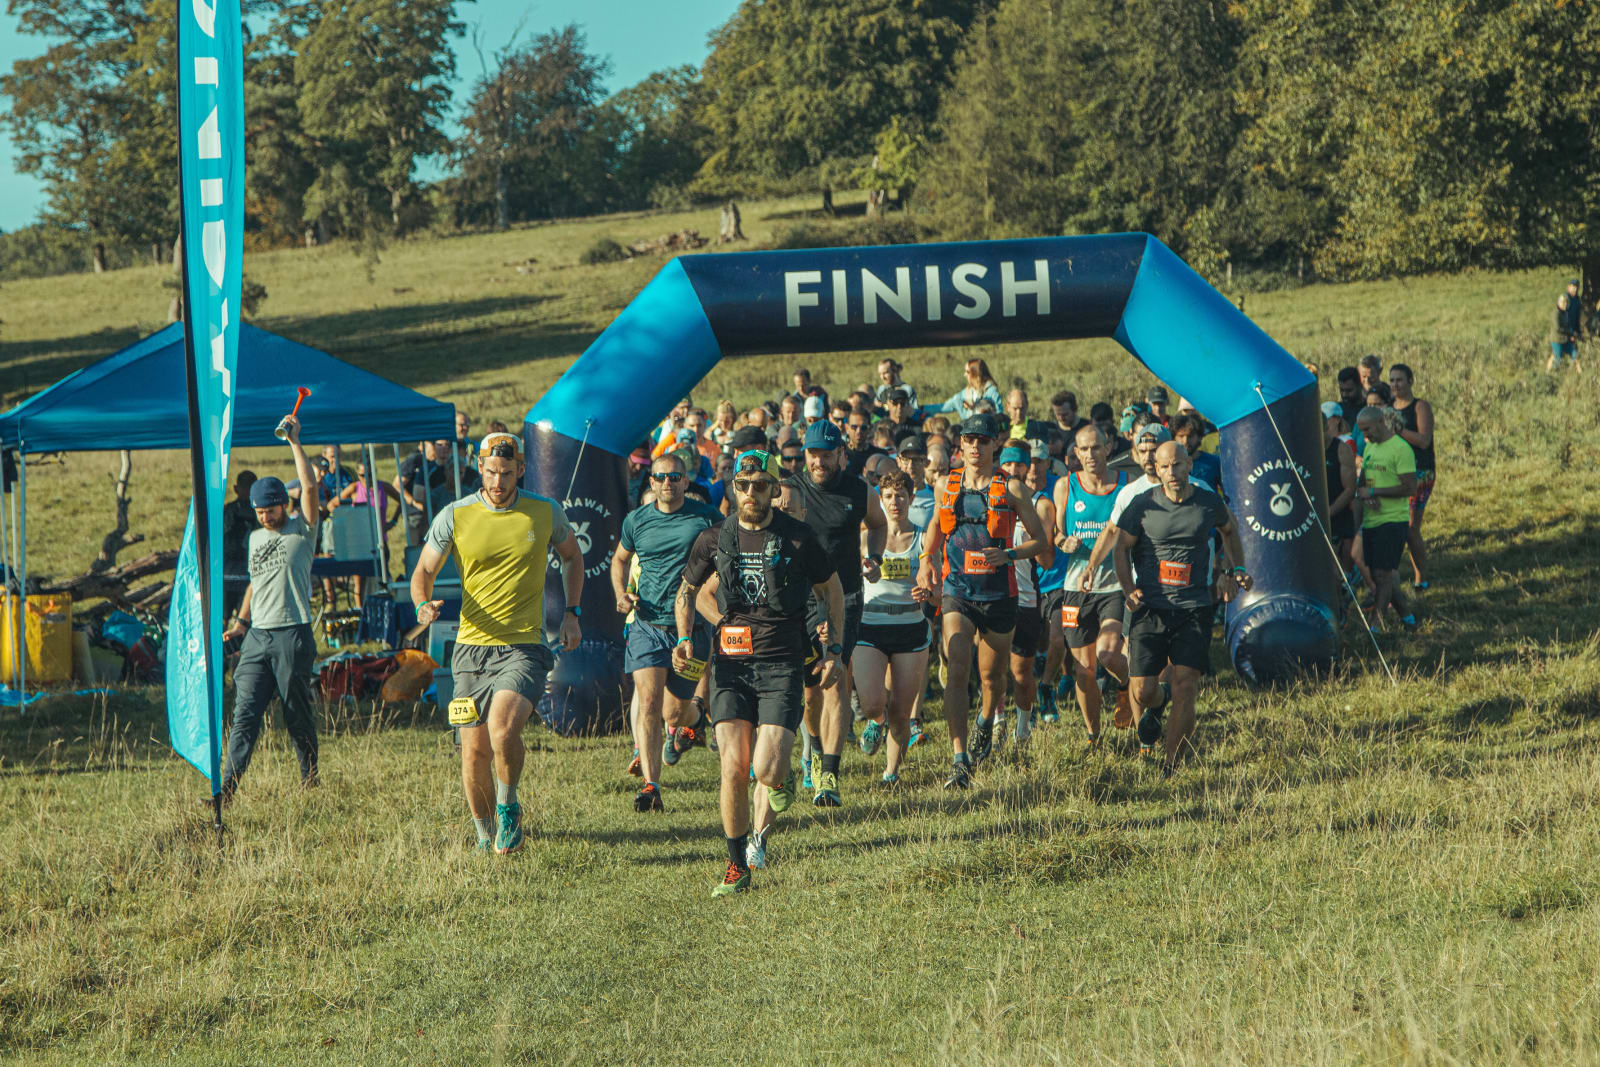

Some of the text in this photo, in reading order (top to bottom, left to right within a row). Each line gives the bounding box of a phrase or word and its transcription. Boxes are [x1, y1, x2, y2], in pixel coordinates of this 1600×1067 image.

[784, 259, 1051, 327] FINISH
[1247, 458, 1311, 484] RUNAWAY
[562, 497, 612, 518] NAWAY
[1245, 511, 1316, 541] ADVENTURES
[727, 635, 743, 644] 084
